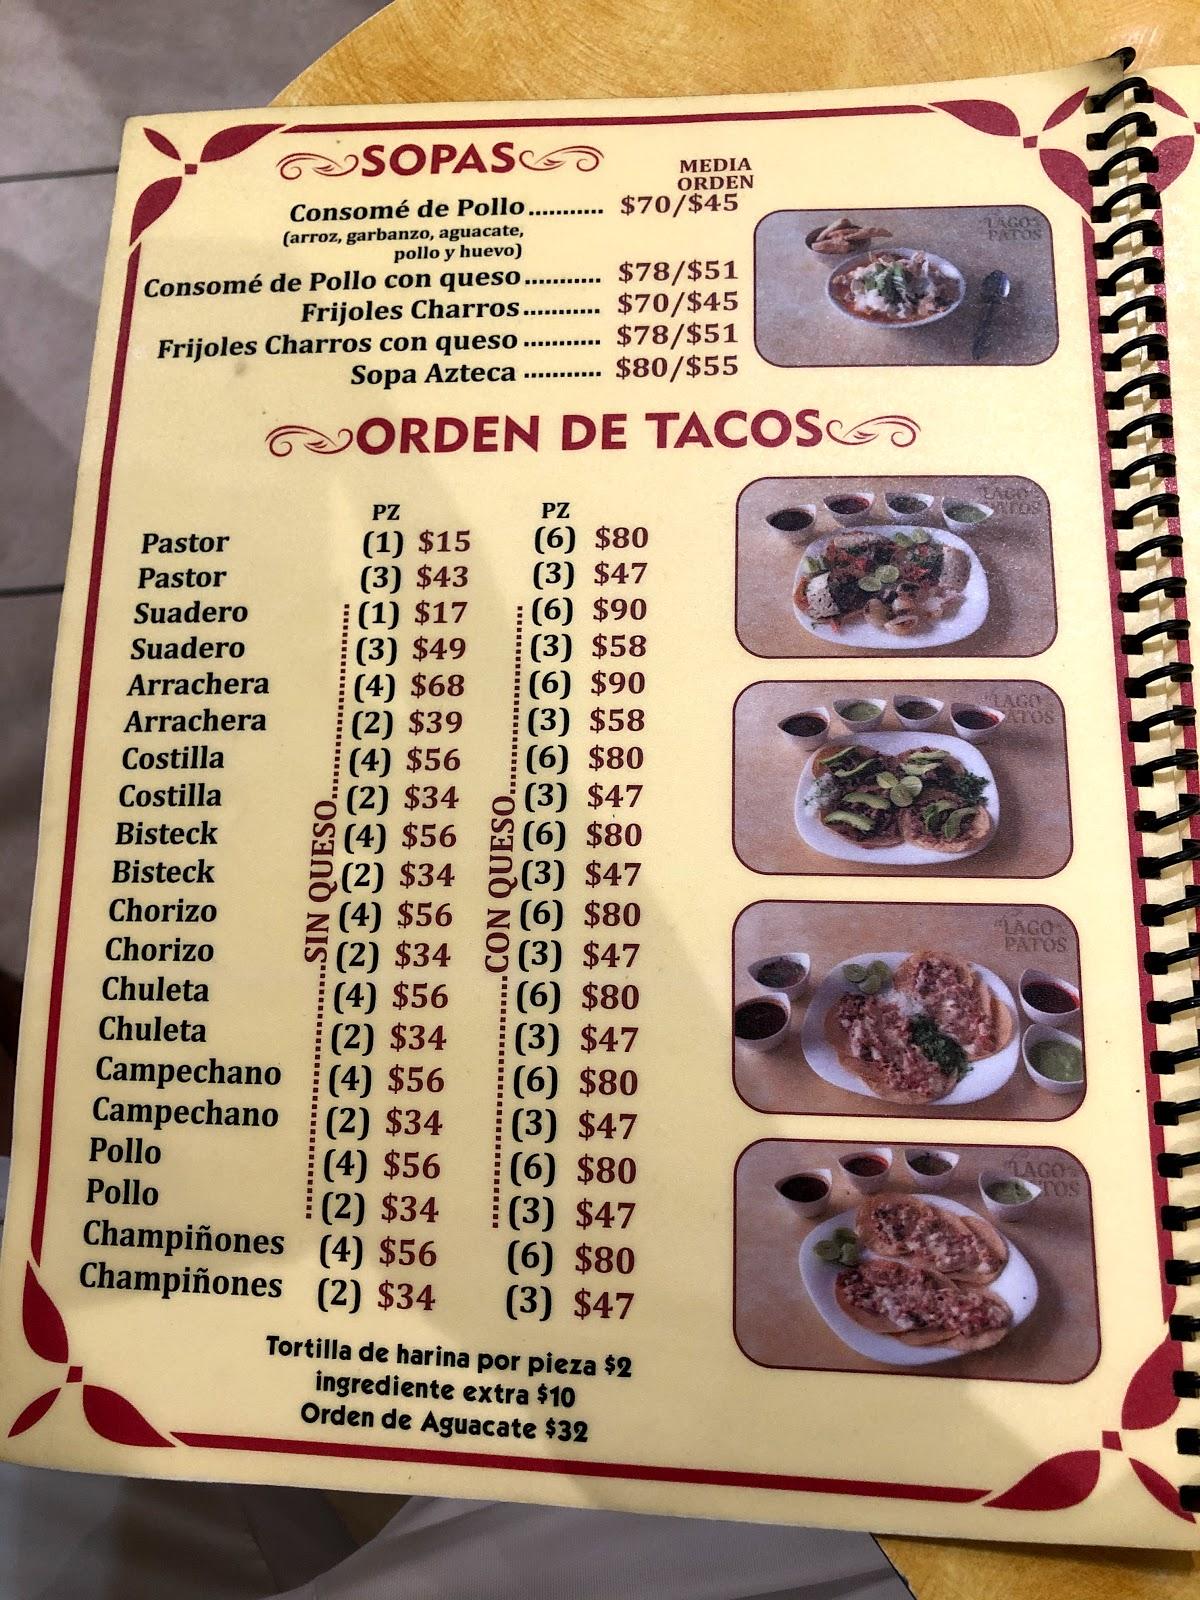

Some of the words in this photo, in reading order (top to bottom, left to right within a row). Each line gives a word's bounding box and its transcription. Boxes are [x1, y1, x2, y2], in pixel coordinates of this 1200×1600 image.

[362, 142, 515, 177] SOPAS
[680, 158, 752, 173] MEDIA
[678, 175, 754, 191] ORDEN
[290, 200, 409, 222] Consomé
[418, 199, 449, 218] de
[621, 193, 738, 218] $70/$45
[283, 231, 342, 247] (arroz,
[346, 228, 434, 245] garbanzo,
[439, 225, 523, 241] aguacate,
[394, 246, 440, 263] pollo
[444, 249, 455, 262] y
[460, 243, 522, 259] huevo)
[144, 273, 262, 297] Consomé
[270, 273, 302, 293] de
[309, 270, 376, 291] Pollo
[385, 274, 431, 288] con
[619, 259, 737, 286] $78/$51
[301, 301, 403, 326] Frijoles
[618, 290, 738, 317] $70/$45
[157, 336, 257, 363] Frijoles
[265, 334, 371, 355] Charros
[380, 337, 427, 351] con
[617, 322, 738, 350] $78/$51
[351, 365, 416, 390] Sopa
[616, 355, 738, 383] $80/$55
[357, 415, 539, 455] ORDEN
[562, 414, 627, 450] DE
[645, 409, 823, 448] TACOS
[372, 504, 400, 520] PZ
[542, 502, 570, 519] PZ
[141, 533, 230, 554] Pastor
[363, 531, 403, 559] (1)
[419, 529, 470, 554] $15
[535, 526, 575, 554] (6)
[595, 525, 648, 550] $80
[138, 568, 227, 589] Pastor
[361, 566, 401, 594] (3)
[417, 564, 468, 590] $43
[533, 561, 574, 590] (3)
[594, 561, 648, 586] $47
[134, 601, 248, 624] Suadero
[359, 601, 399, 630] (1)
[415, 600, 468, 625] $17
[532, 597, 573, 626] (6)
[593, 597, 647, 622] $90
[131, 636, 245, 660] Suadero
[356, 637, 397, 666] (3)
[413, 636, 466, 662] $49
[531, 634, 572, 663] (3)
[592, 633, 646, 659] $58
[126, 672, 269, 696] Arrachera
[354, 674, 395, 703] (4)
[411, 672, 464, 699] $68
[529, 670, 571, 700] (6)
[591, 670, 645, 696] $90
[123, 708, 266, 733] Arrachera
[352, 711, 393, 740] (2)
[409, 709, 462, 736] $39
[528, 707, 569, 737] (3)
[590, 707, 644, 733] $58
[122, 745, 224, 770] Costilla
[350, 748, 391, 777] (4)
[407, 746, 460, 773] $56
[527, 745, 568, 775] (6)
[589, 744, 643, 771] $80
[119, 783, 221, 807] Costilla
[347, 785, 388, 815] (2)
[404, 784, 459, 811] $34
[525, 783, 567, 813] (3)
[588, 782, 643, 810] $47
[115, 821, 218, 845] Bisteck
[345, 824, 386, 854] (4)
[402, 822, 456, 850] $56
[523, 821, 565, 852] (6)
[587, 821, 642, 848] $80
[309, 801, 337, 902] QUESO
[488, 796, 518, 898] QUESO
[112, 859, 215, 883] Bisteck
[342, 862, 383, 893] (2)
[400, 861, 455, 889] $34
[522, 860, 564, 891] (3)
[586, 860, 641, 888] $47
[109, 898, 217, 922] Chorizo
[339, 902, 381, 933] (4)
[398, 900, 452, 928] $56
[520, 900, 563, 931] (6)
[584, 900, 640, 928] $80
[304, 912, 329, 963] SIN
[485, 908, 510, 973] CON
[1005, 937, 1067, 952] PATOS
[106, 937, 214, 962] Chorizo
[337, 942, 379, 974] (2)
[395, 940, 451, 969] $34
[519, 940, 562, 972] (3)
[583, 940, 640, 970] $47
[102, 976, 209, 1002] Chuleta
[334, 982, 376, 1015] (4)
[393, 981, 448, 1010] $56
[517, 981, 560, 1014] (6)
[582, 981, 639, 1011] $80
[96, 1056, 281, 1089] Campechano
[329, 1065, 371, 1098] (4)
[388, 1064, 444, 1094] $56
[514, 1065, 558, 1100] (6)
[580, 1066, 638, 1097] $80
[93, 1097, 278, 1130] Campechano
[327, 1107, 369, 1140] (2)
[386, 1106, 443, 1136] $34
[512, 1108, 556, 1143] (3)
[579, 1110, 637, 1141] $47
[89, 1137, 161, 1164] Pollo
[324, 1149, 367, 1183] (4)
[384, 1149, 440, 1180] $56
[511, 1152, 555, 1187] (6)
[578, 1153, 636, 1185] $80
[86, 1178, 158, 1206] Pollo
[322, 1192, 365, 1226] (2)
[382, 1192, 439, 1223] $34
[509, 1196, 554, 1232] (3)
[576, 1198, 636, 1230] $47
[83, 1220, 285, 1256] Champiñones
[320, 1234, 363, 1270] (4)
[380, 1236, 437, 1267] $56
[508, 1240, 553, 1277] (6)
[576, 1243, 635, 1275] $80
[80, 1262, 282, 1299] Champiñones
[318, 1278, 361, 1314] (2)
[378, 1280, 436, 1311] $34
[506, 1285, 552, 1321] (3)
[574, 1288, 634, 1320] $47
[266, 1335, 351, 1360] Tortilla
[359, 1342, 389, 1363] de
[397, 1344, 469, 1368] harina
[478, 1353, 521, 1373] por
[529, 1352, 596, 1376] pieza
[604, 1354, 632, 1378] $2
[316, 1370, 455, 1400] ingrediente
[463, 1384, 528, 1405] extra
[537, 1383, 575, 1408] $10
[301, 1402, 374, 1427] Orden
[382, 1409, 412, 1430] de
[420, 1411, 536, 1439] Aguacate
[545, 1418, 588, 1442] $32
